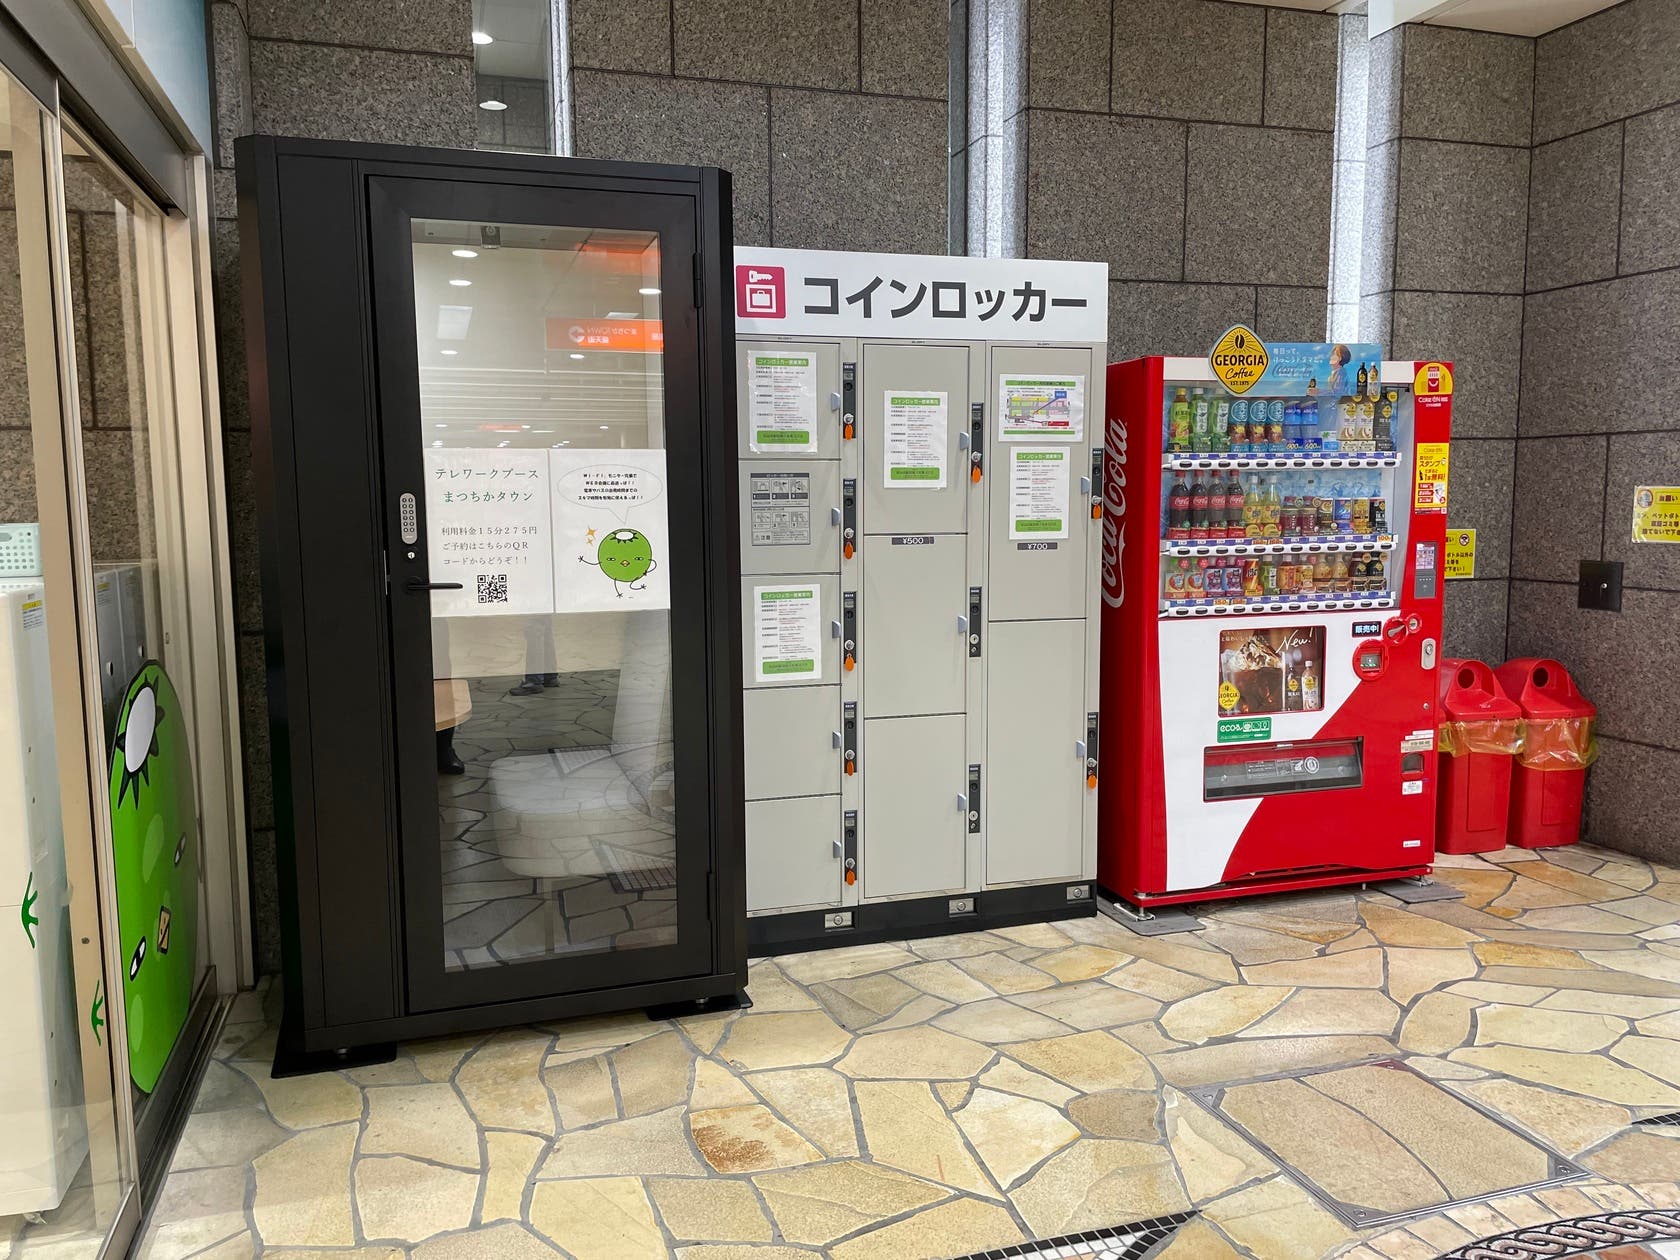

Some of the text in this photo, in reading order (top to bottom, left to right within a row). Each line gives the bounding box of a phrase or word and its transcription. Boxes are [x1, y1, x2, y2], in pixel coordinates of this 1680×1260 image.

[804, 275, 1087, 322] コインロッカー
[1215, 354, 1265, 366] GEORGIA
[1225, 367, 1255, 380] Coffee
[435, 468, 539, 480] テレワークブース
[443, 491, 533, 503] まつちかタウン
[441, 526, 538, 537] 利用料金15分275円
[442, 541, 529, 551] ご予約はこちらのQR
[902, 537, 924, 545] ¥500
[443, 556, 528, 565] コードからどうぞ！！
[1275, 627, 1314, 653] New!
